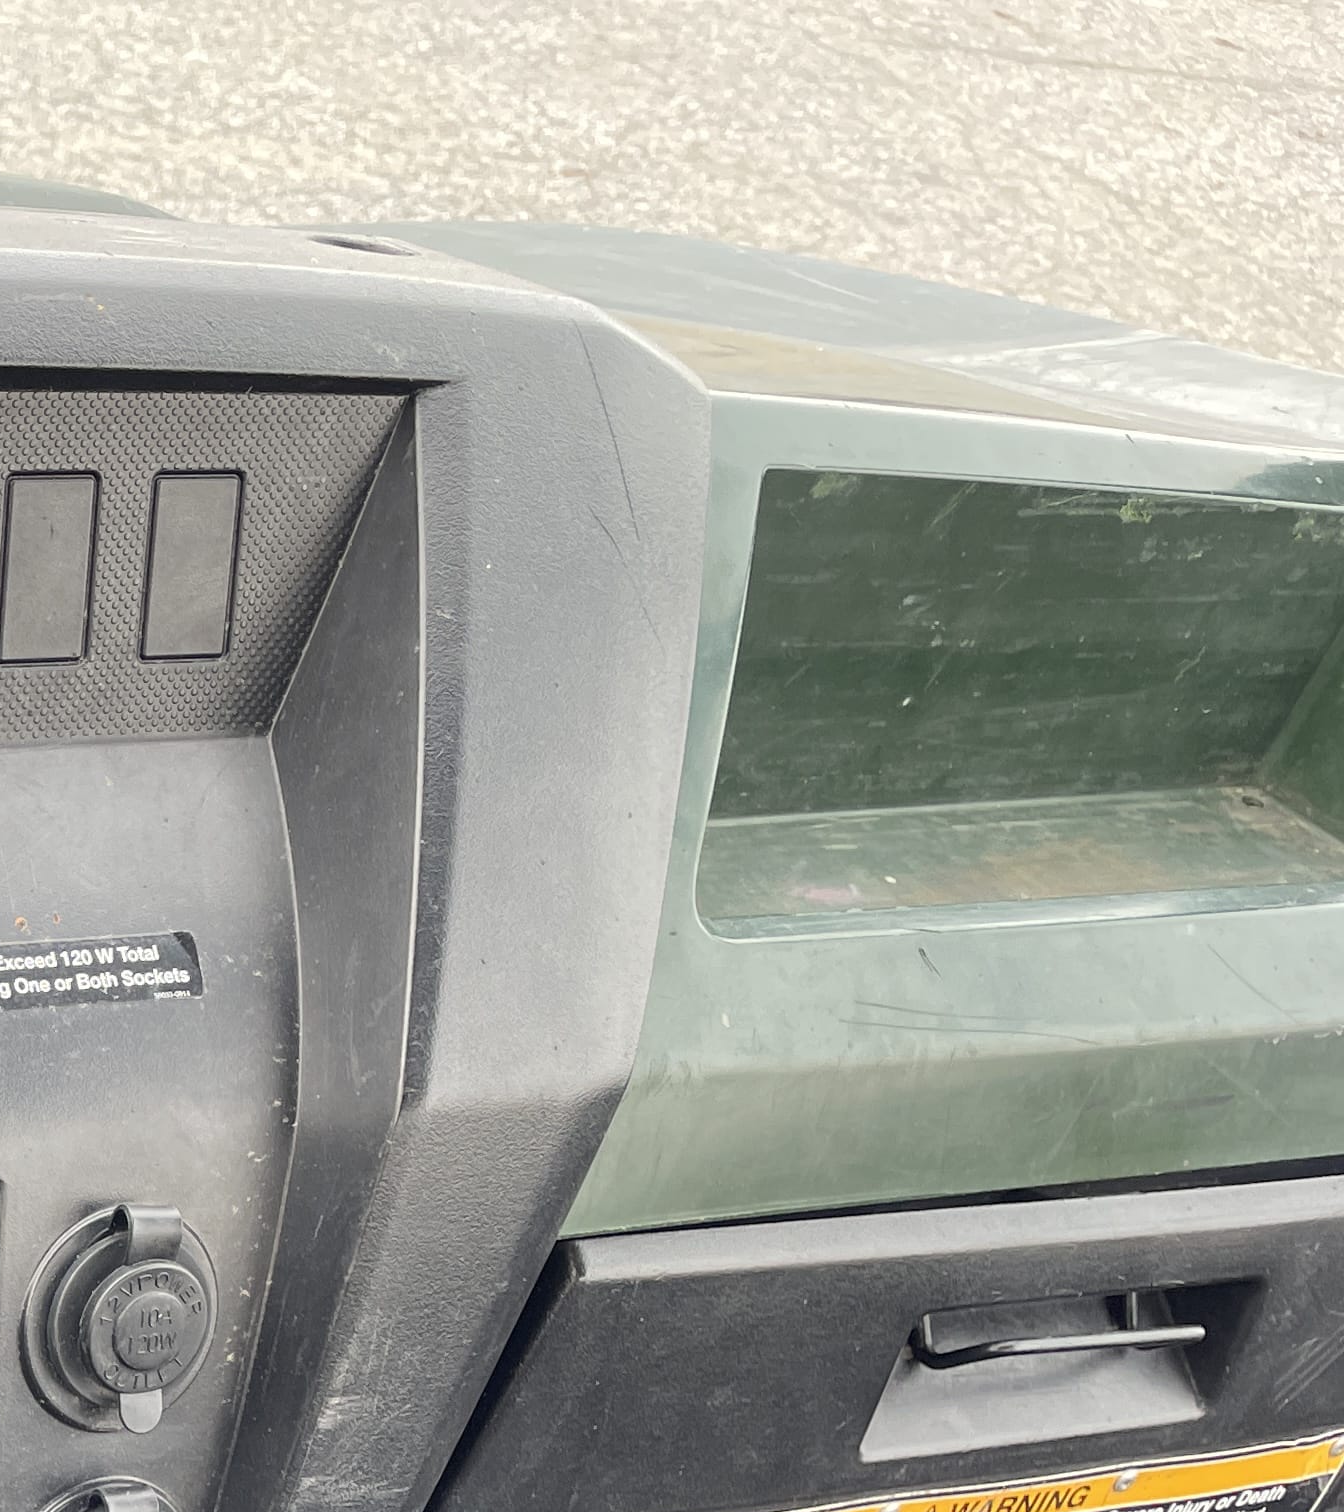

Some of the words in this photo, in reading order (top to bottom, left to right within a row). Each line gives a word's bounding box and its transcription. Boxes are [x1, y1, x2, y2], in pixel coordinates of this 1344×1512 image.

[59, 949, 93, 967] 120
[95, 948, 115, 965] W
[116, 944, 160, 962] Total
[13, 976, 52, 994] One
[54, 975, 74, 991] or
[76, 970, 119, 991] Both
[120, 967, 191, 988] Sockets
[1215, 1495, 1235, 1508] or
[1235, 1485, 1287, 1507] Death
